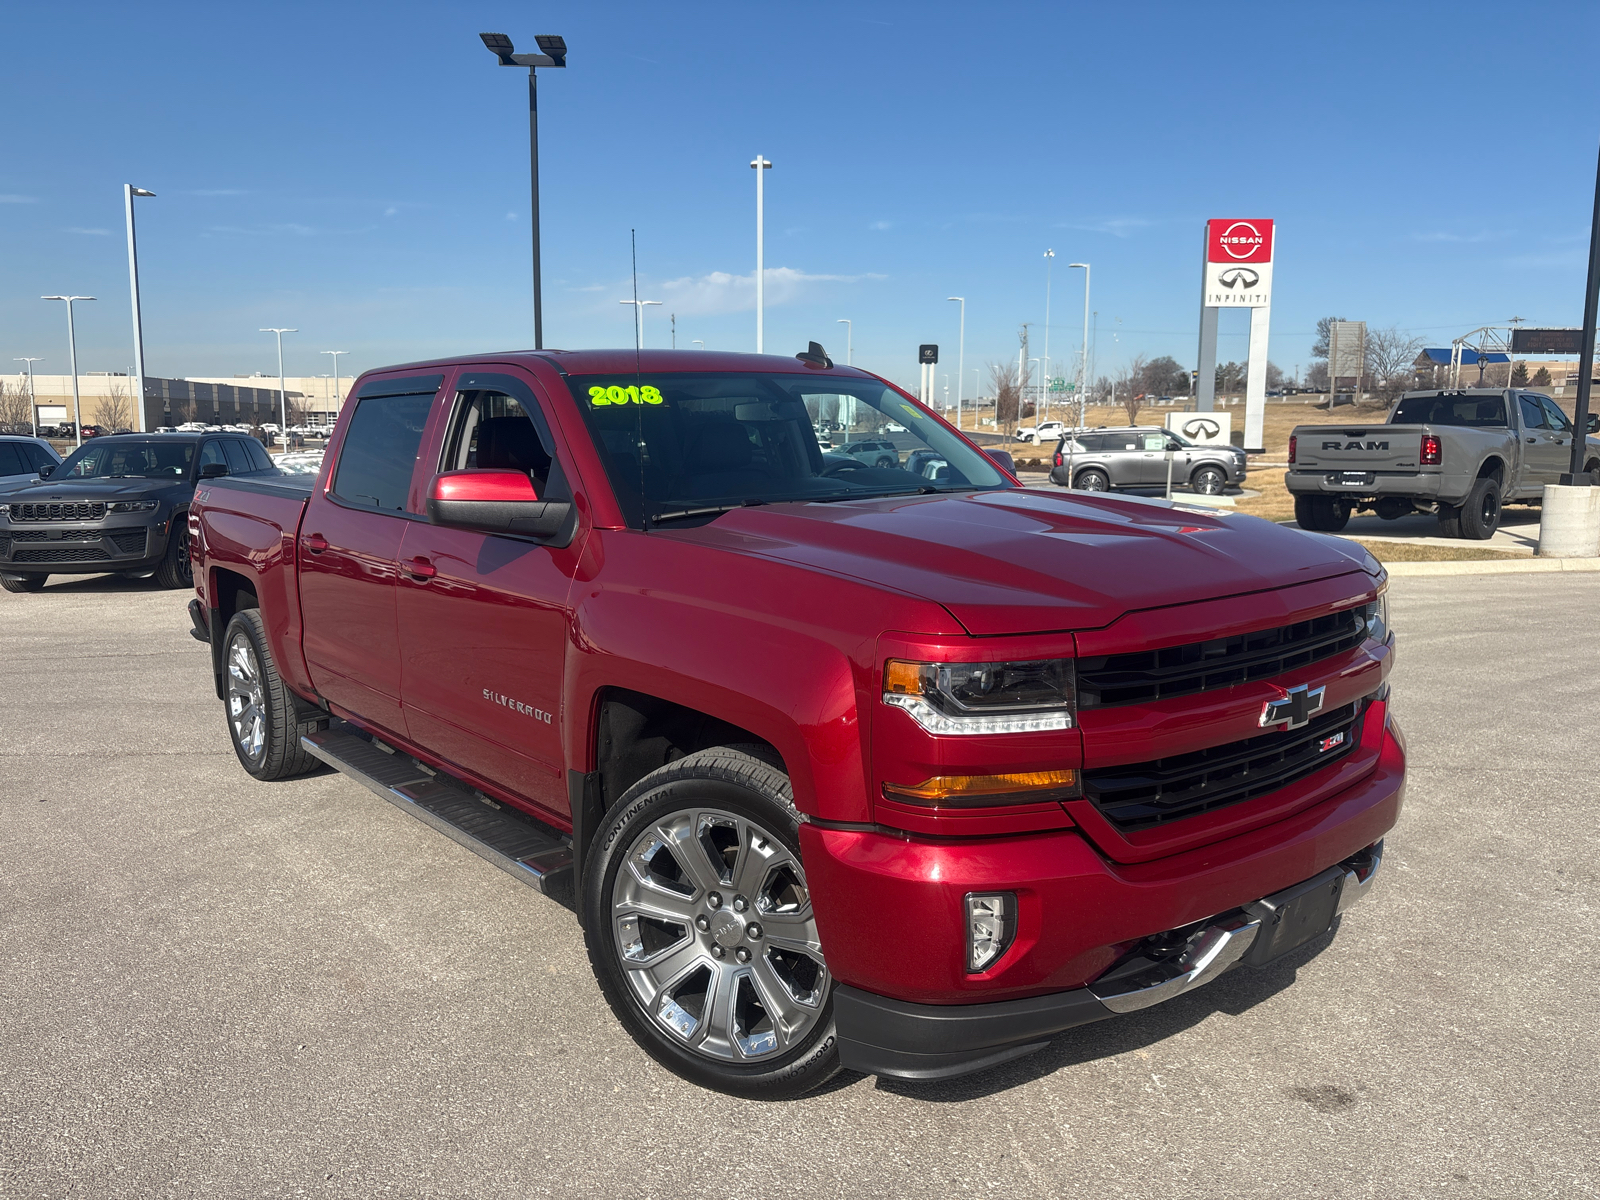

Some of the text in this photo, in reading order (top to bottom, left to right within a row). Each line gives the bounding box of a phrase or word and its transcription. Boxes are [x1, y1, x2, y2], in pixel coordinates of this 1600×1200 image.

[1220, 236, 1263, 244] NISSAN
[1208, 294, 1267, 303] INFINITI
[588, 385, 663, 405] 2018
[1321, 441, 1389, 451] RAM
[194, 489, 211, 503] Z71
[482, 688, 553, 725] SILVERADO
[1319, 731, 1344, 753] Z71
[603, 788, 678, 852] CONTINENTAL
